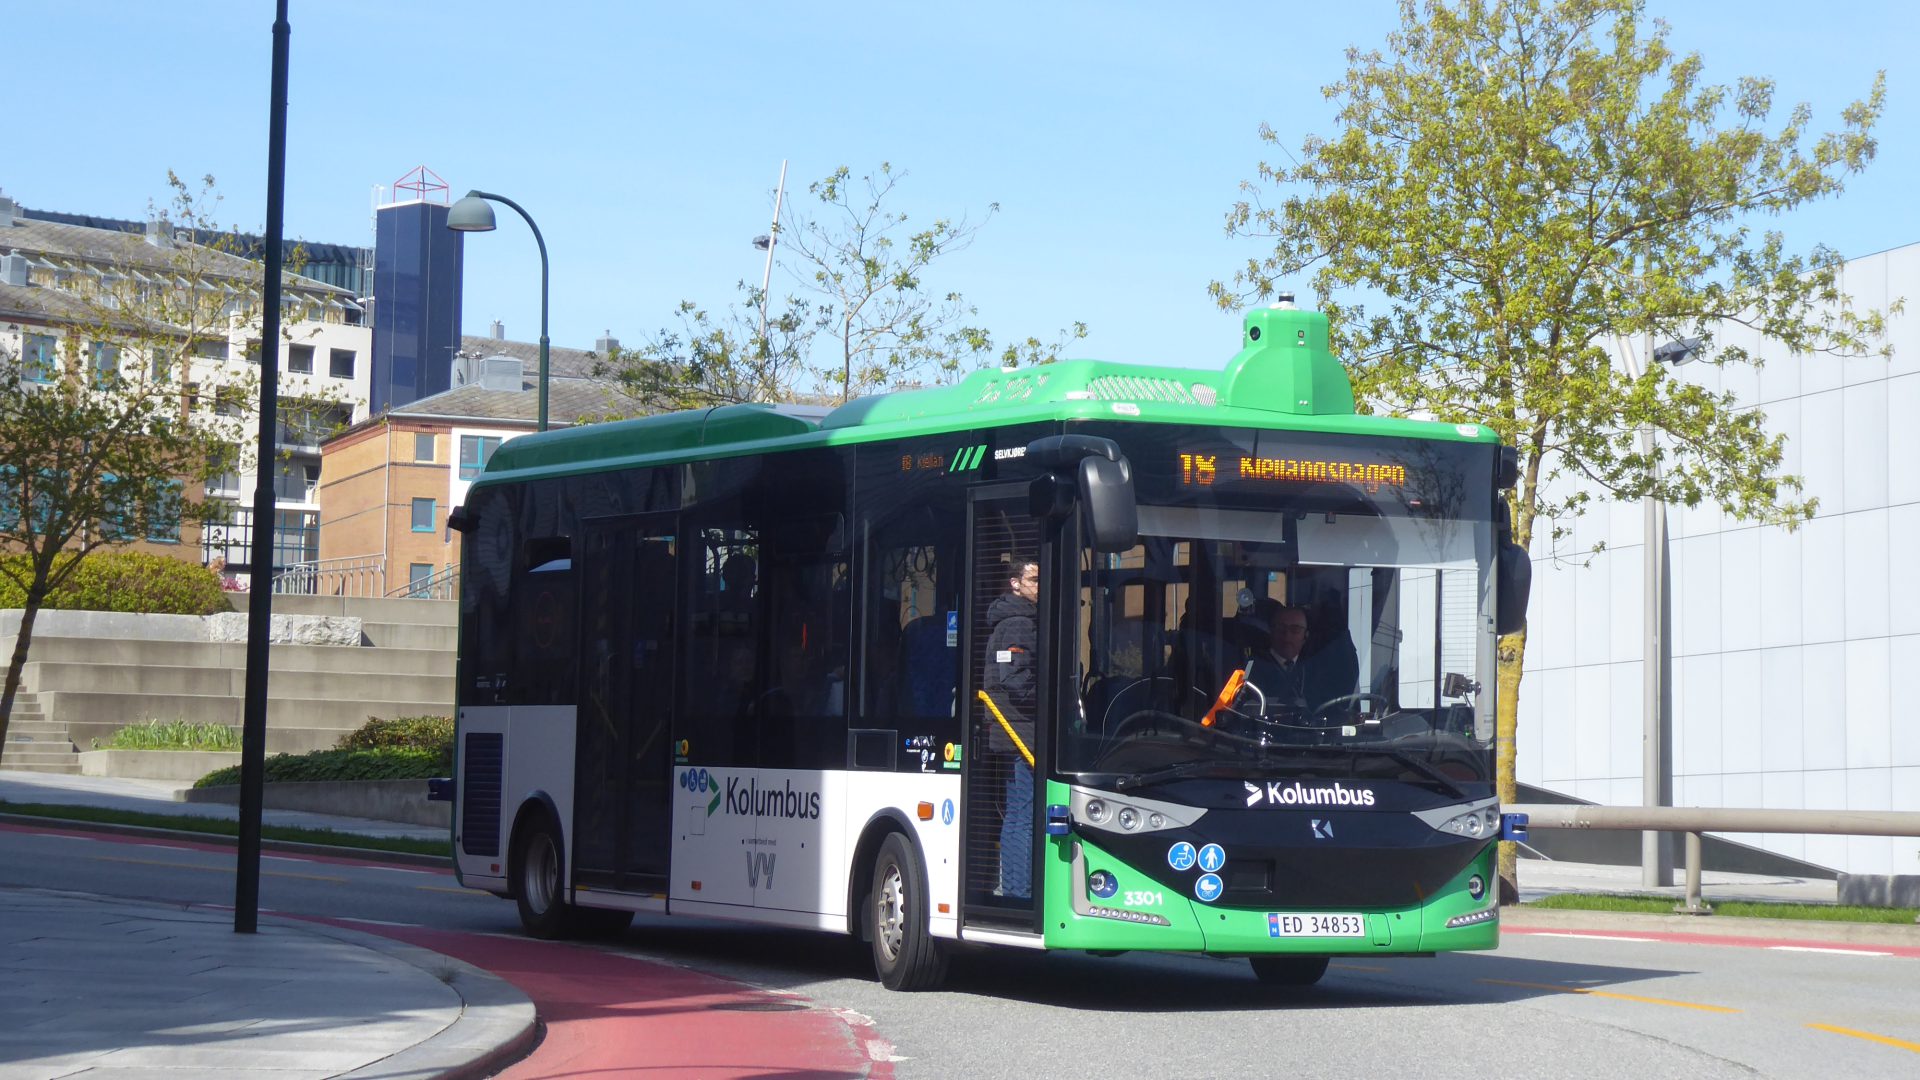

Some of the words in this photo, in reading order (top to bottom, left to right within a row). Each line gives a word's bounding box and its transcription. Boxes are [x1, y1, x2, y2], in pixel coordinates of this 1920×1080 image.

[1180, 454, 1216, 485] 18
[726, 776, 820, 820] Kolumbus
[1267, 781, 1375, 806] Kolumbus
[1124, 891, 1163, 906] 3301
[1282, 916, 1303, 933] ED
[1311, 916, 1360, 933] 34853
